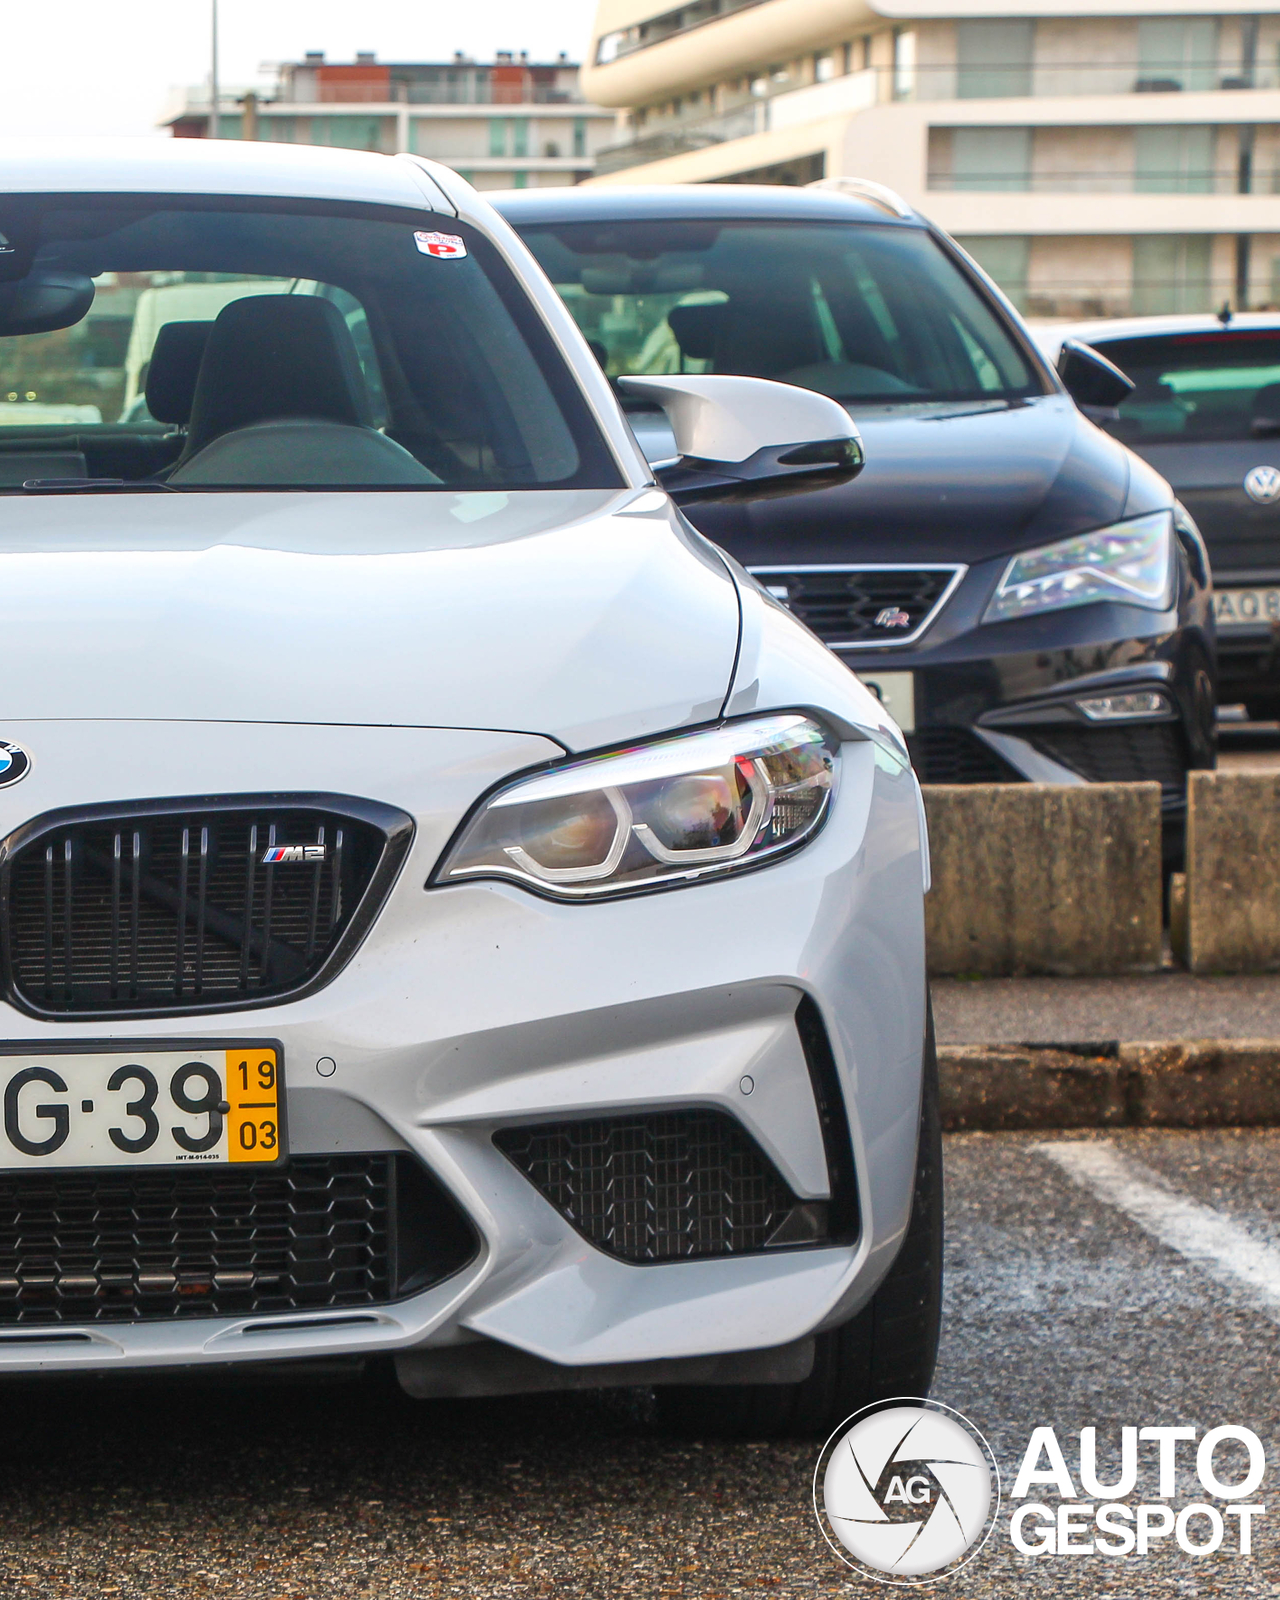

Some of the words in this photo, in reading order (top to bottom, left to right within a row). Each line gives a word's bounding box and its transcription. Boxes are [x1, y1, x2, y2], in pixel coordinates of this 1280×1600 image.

[280, 845, 325, 861] M2
[238, 1060, 276, 1091] 19
[239, 1120, 277, 1150] 03
